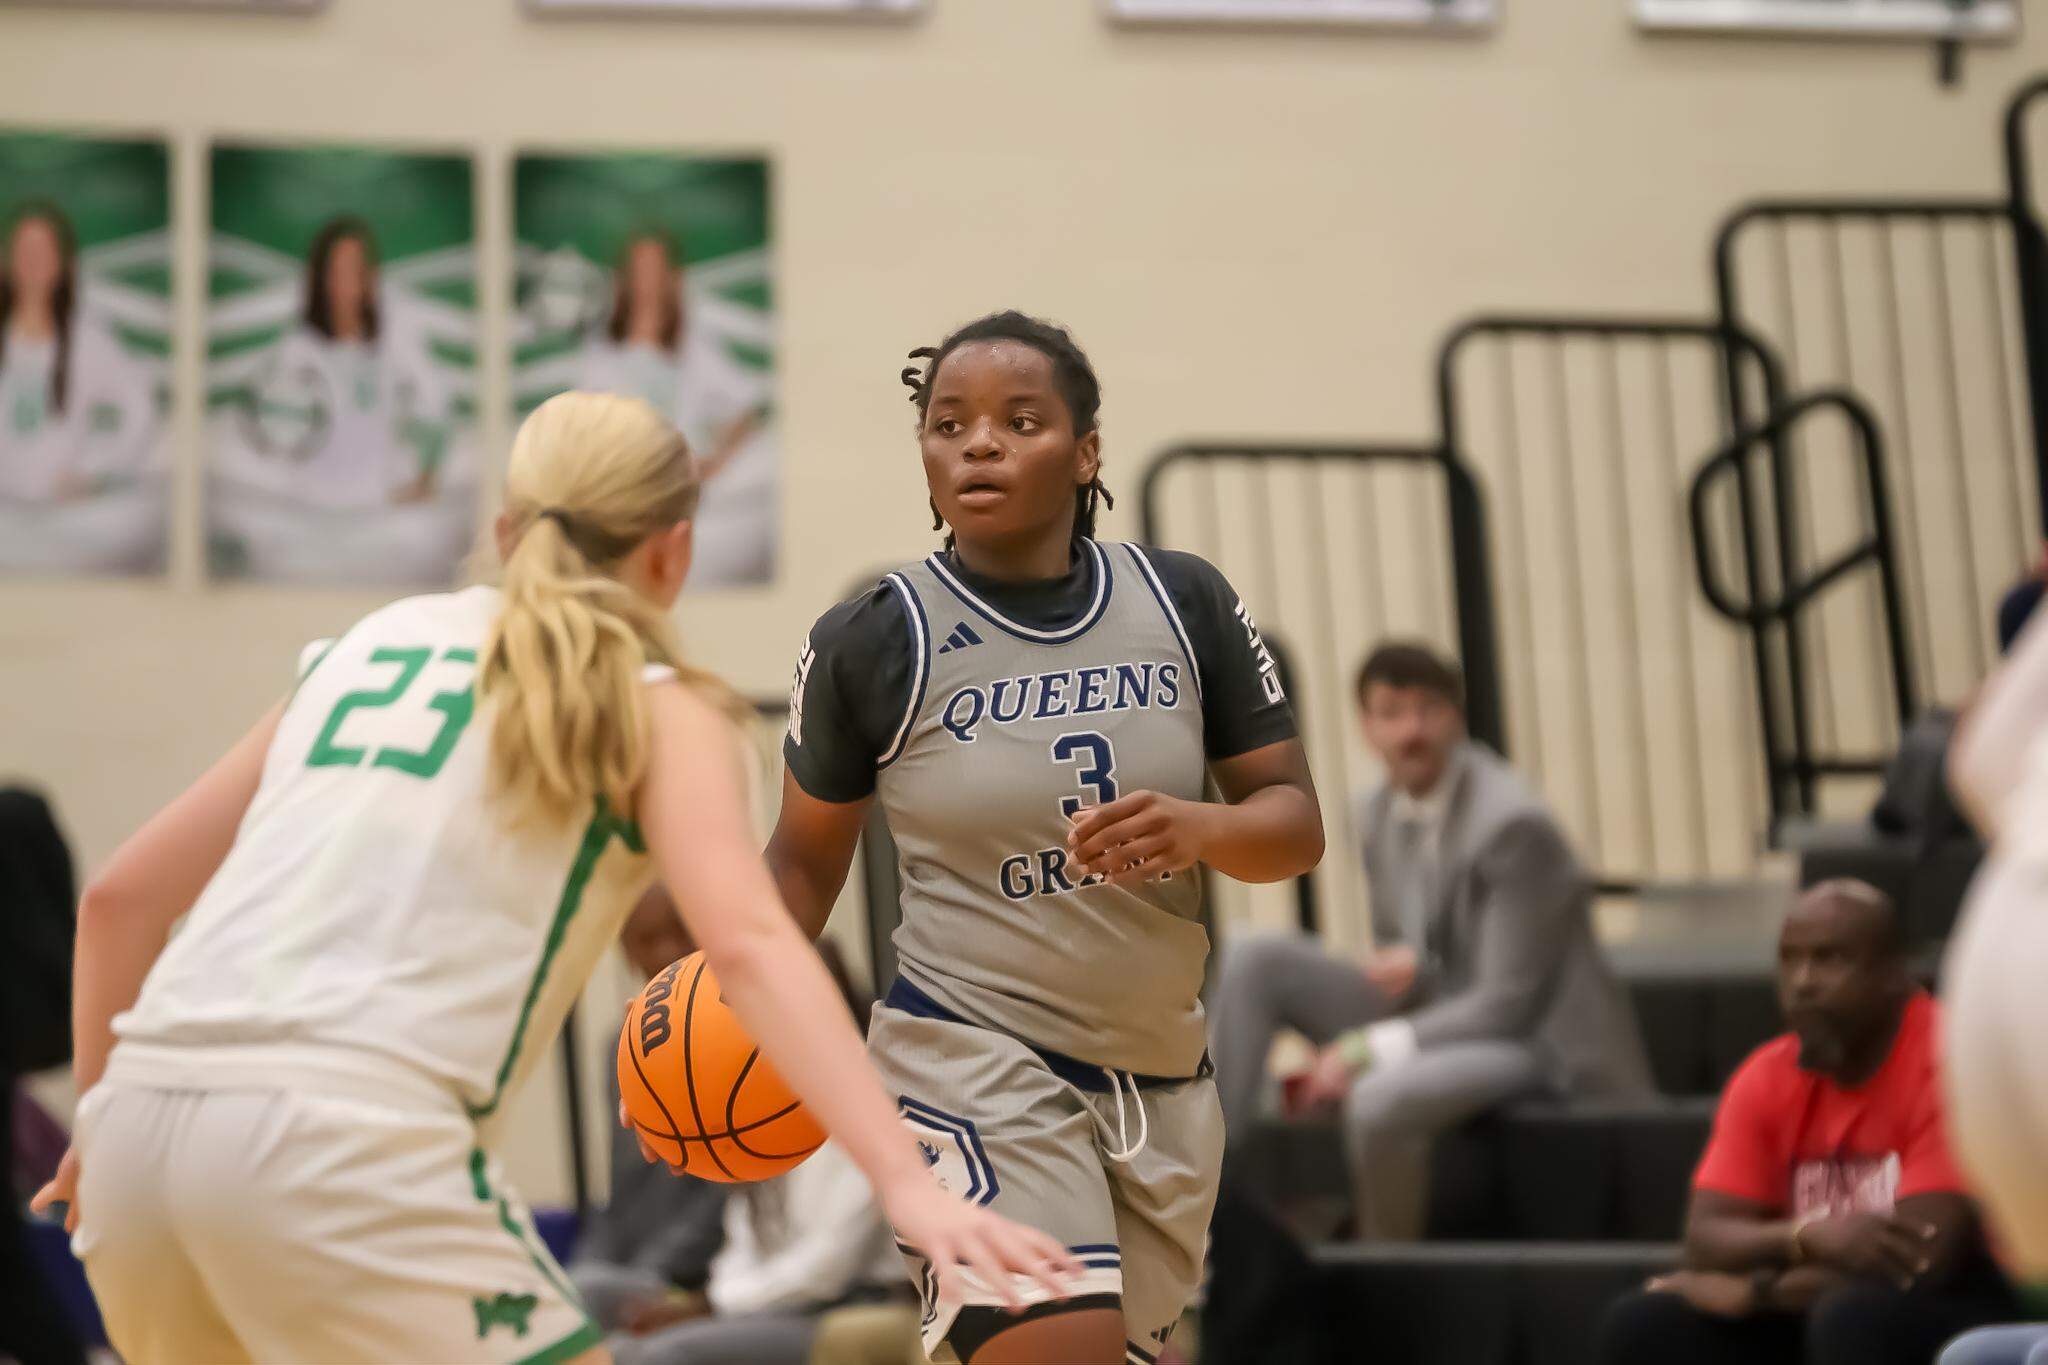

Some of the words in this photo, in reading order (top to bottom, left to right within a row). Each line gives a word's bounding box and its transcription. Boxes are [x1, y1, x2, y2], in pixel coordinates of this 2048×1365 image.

[305, 647, 476, 779] 23
[940, 661, 1181, 743] QUEENS
[1050, 729, 1119, 826] 3
